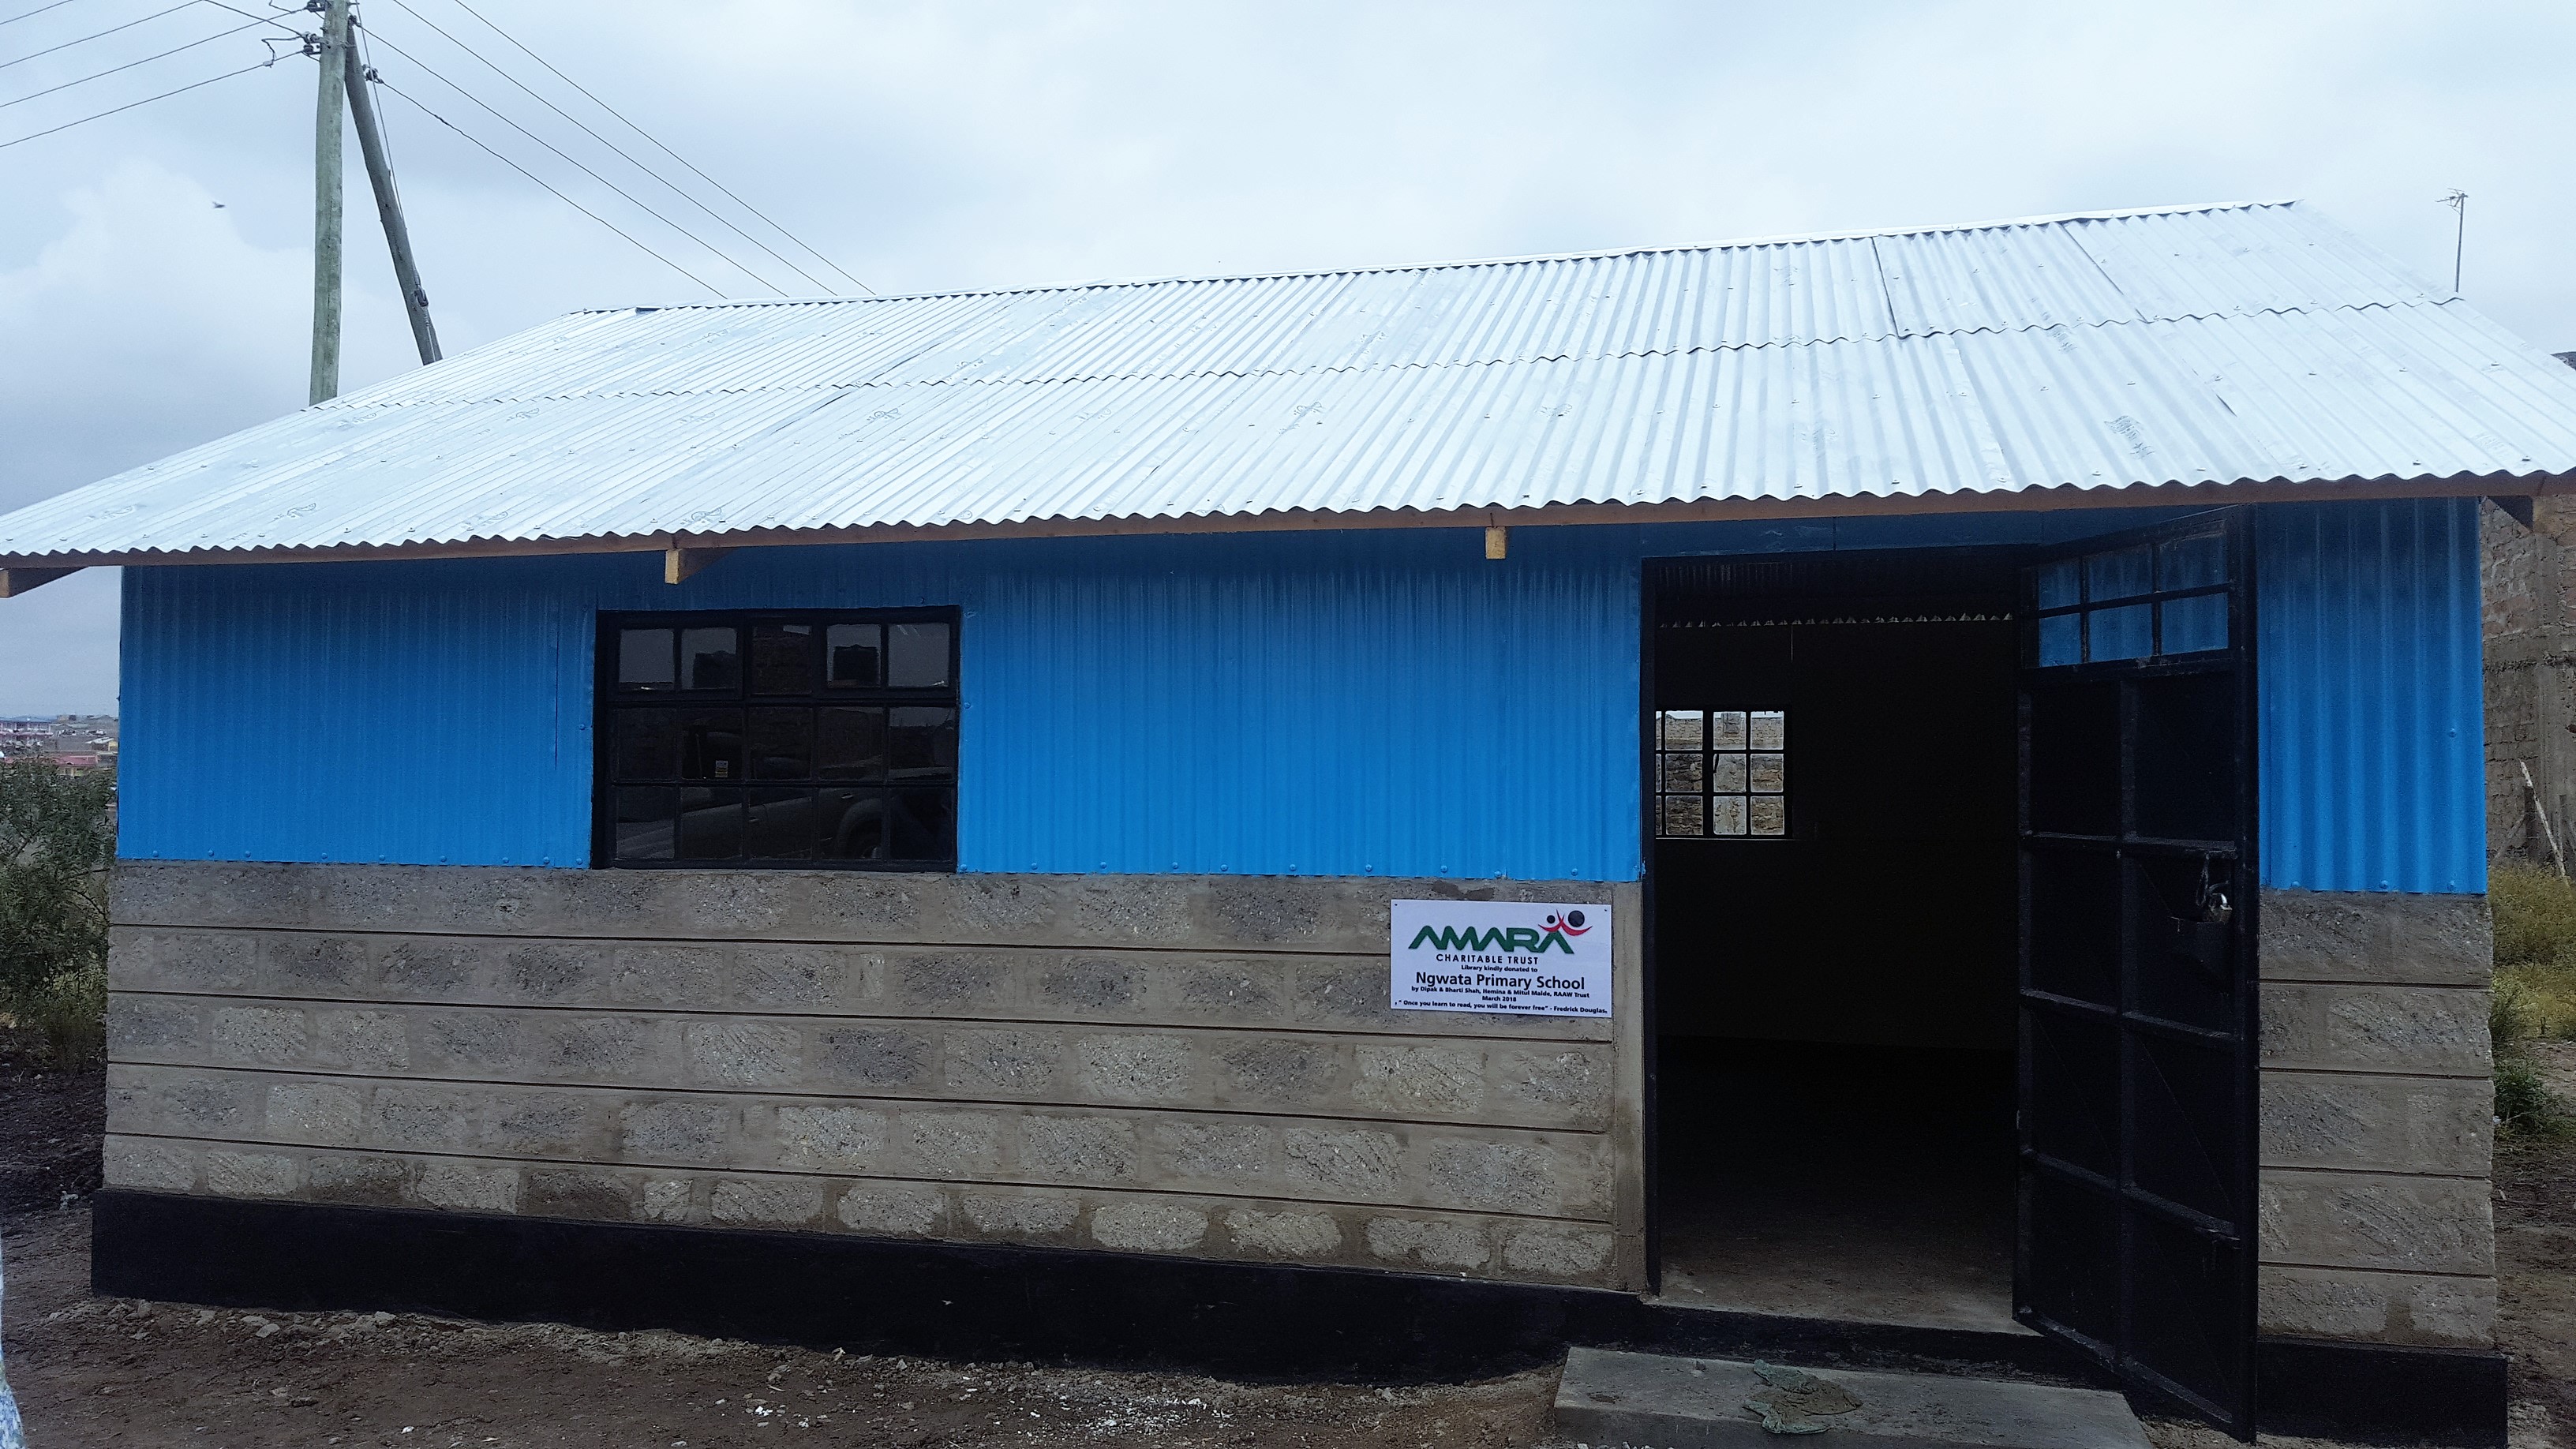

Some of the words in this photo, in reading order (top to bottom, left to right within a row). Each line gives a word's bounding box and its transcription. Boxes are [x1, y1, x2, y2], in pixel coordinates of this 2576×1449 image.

[1409, 926, 1574, 953] AMARA
[1436, 954, 1503, 963] CHARITABLE
[1508, 956, 1538, 964] TRUST
[1416, 972, 1472, 987] Ngwata
[1477, 974, 1532, 990] Primary
[1537, 975, 1585, 989] School
